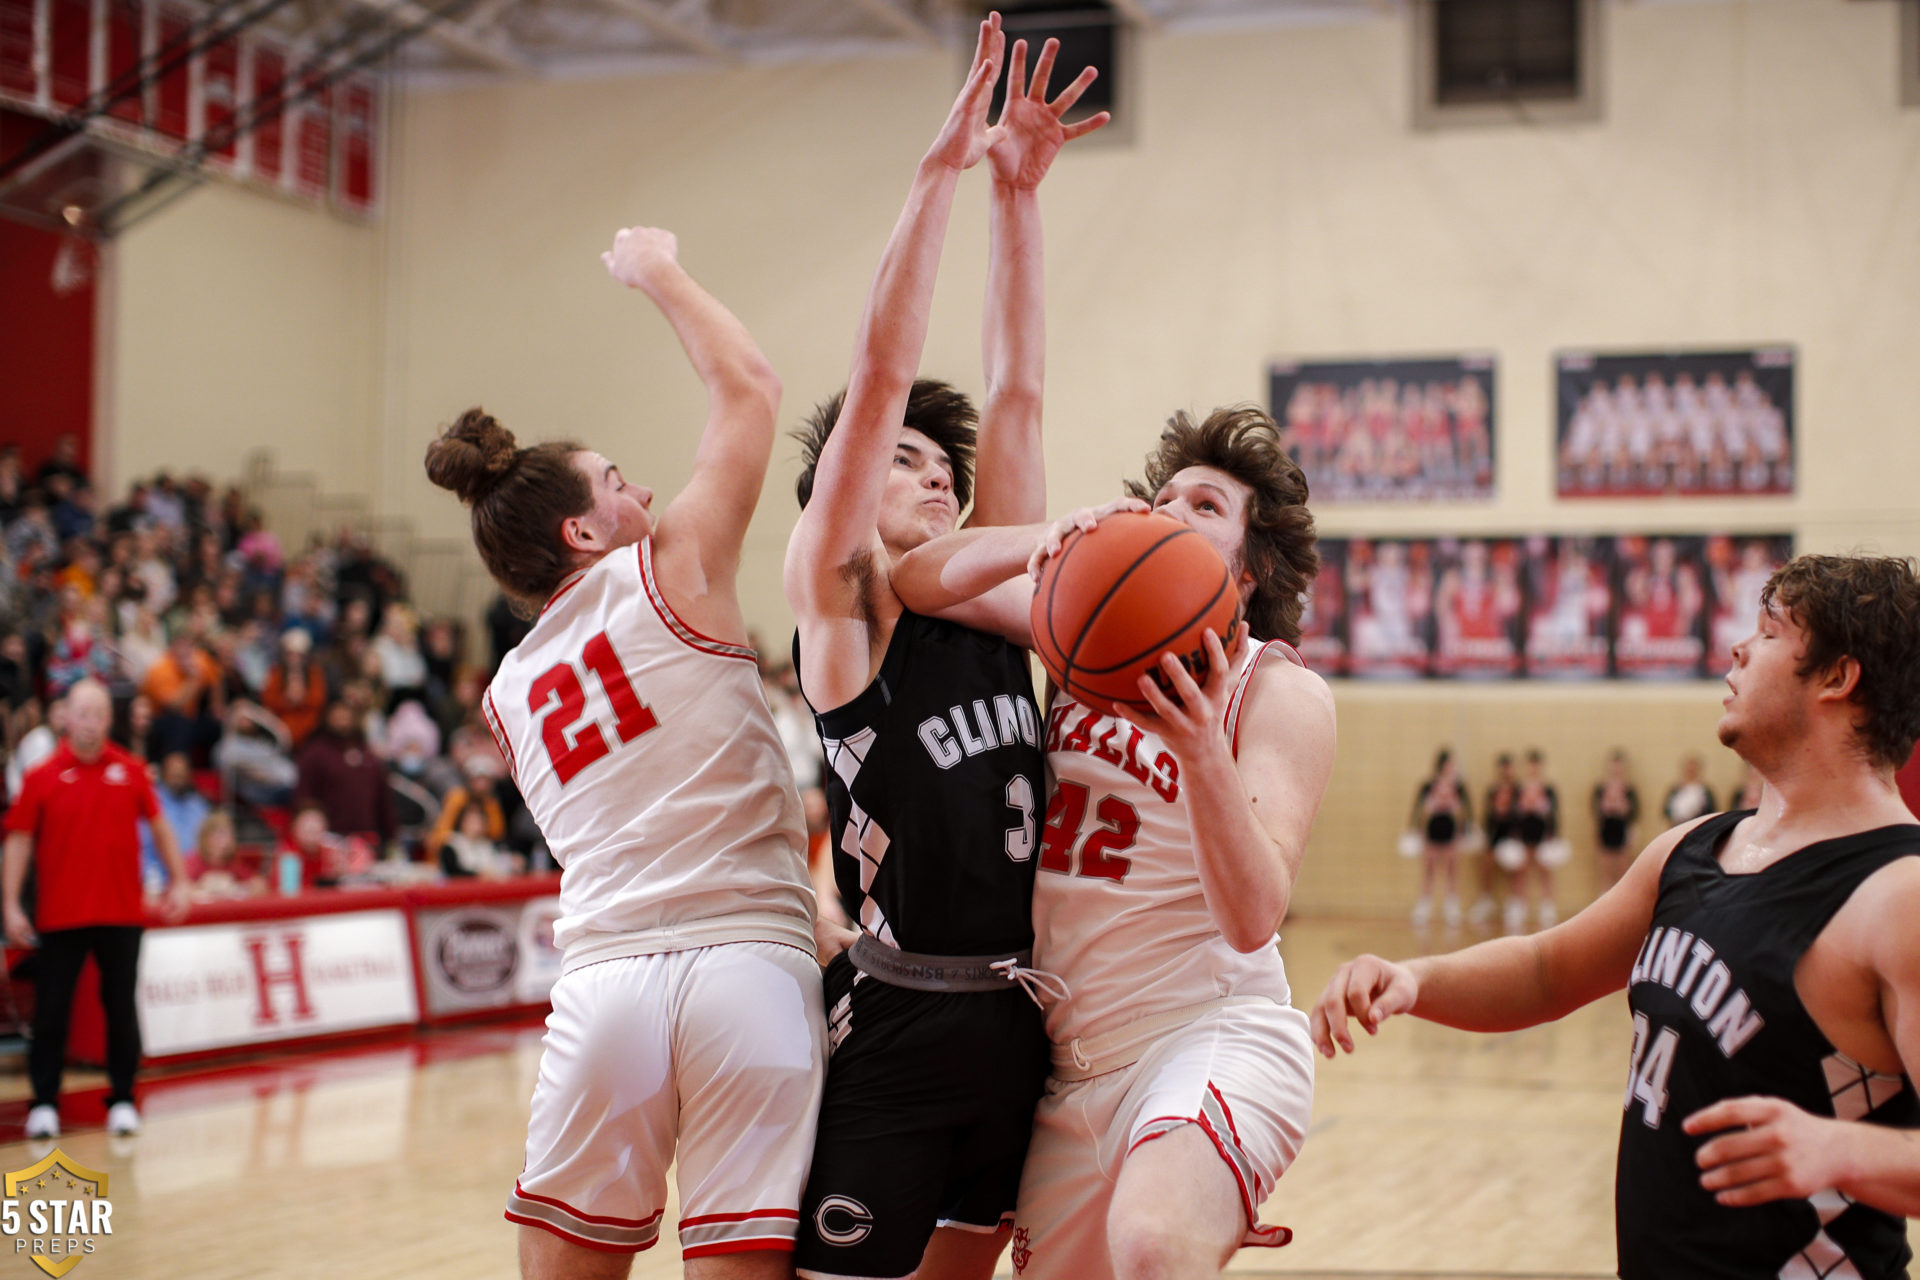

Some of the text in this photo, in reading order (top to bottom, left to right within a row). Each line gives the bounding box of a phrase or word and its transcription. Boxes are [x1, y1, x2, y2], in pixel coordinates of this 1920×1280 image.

[526, 628, 662, 790] 21
[917, 694, 1041, 770] CLINO
[1046, 701, 1180, 804] HALLS
[1005, 774, 1035, 863] 3
[1037, 778, 1142, 885] 42
[244, 932, 317, 1026] H
[1627, 926, 1766, 1059] LINTON
[813, 1194, 874, 1247] C
